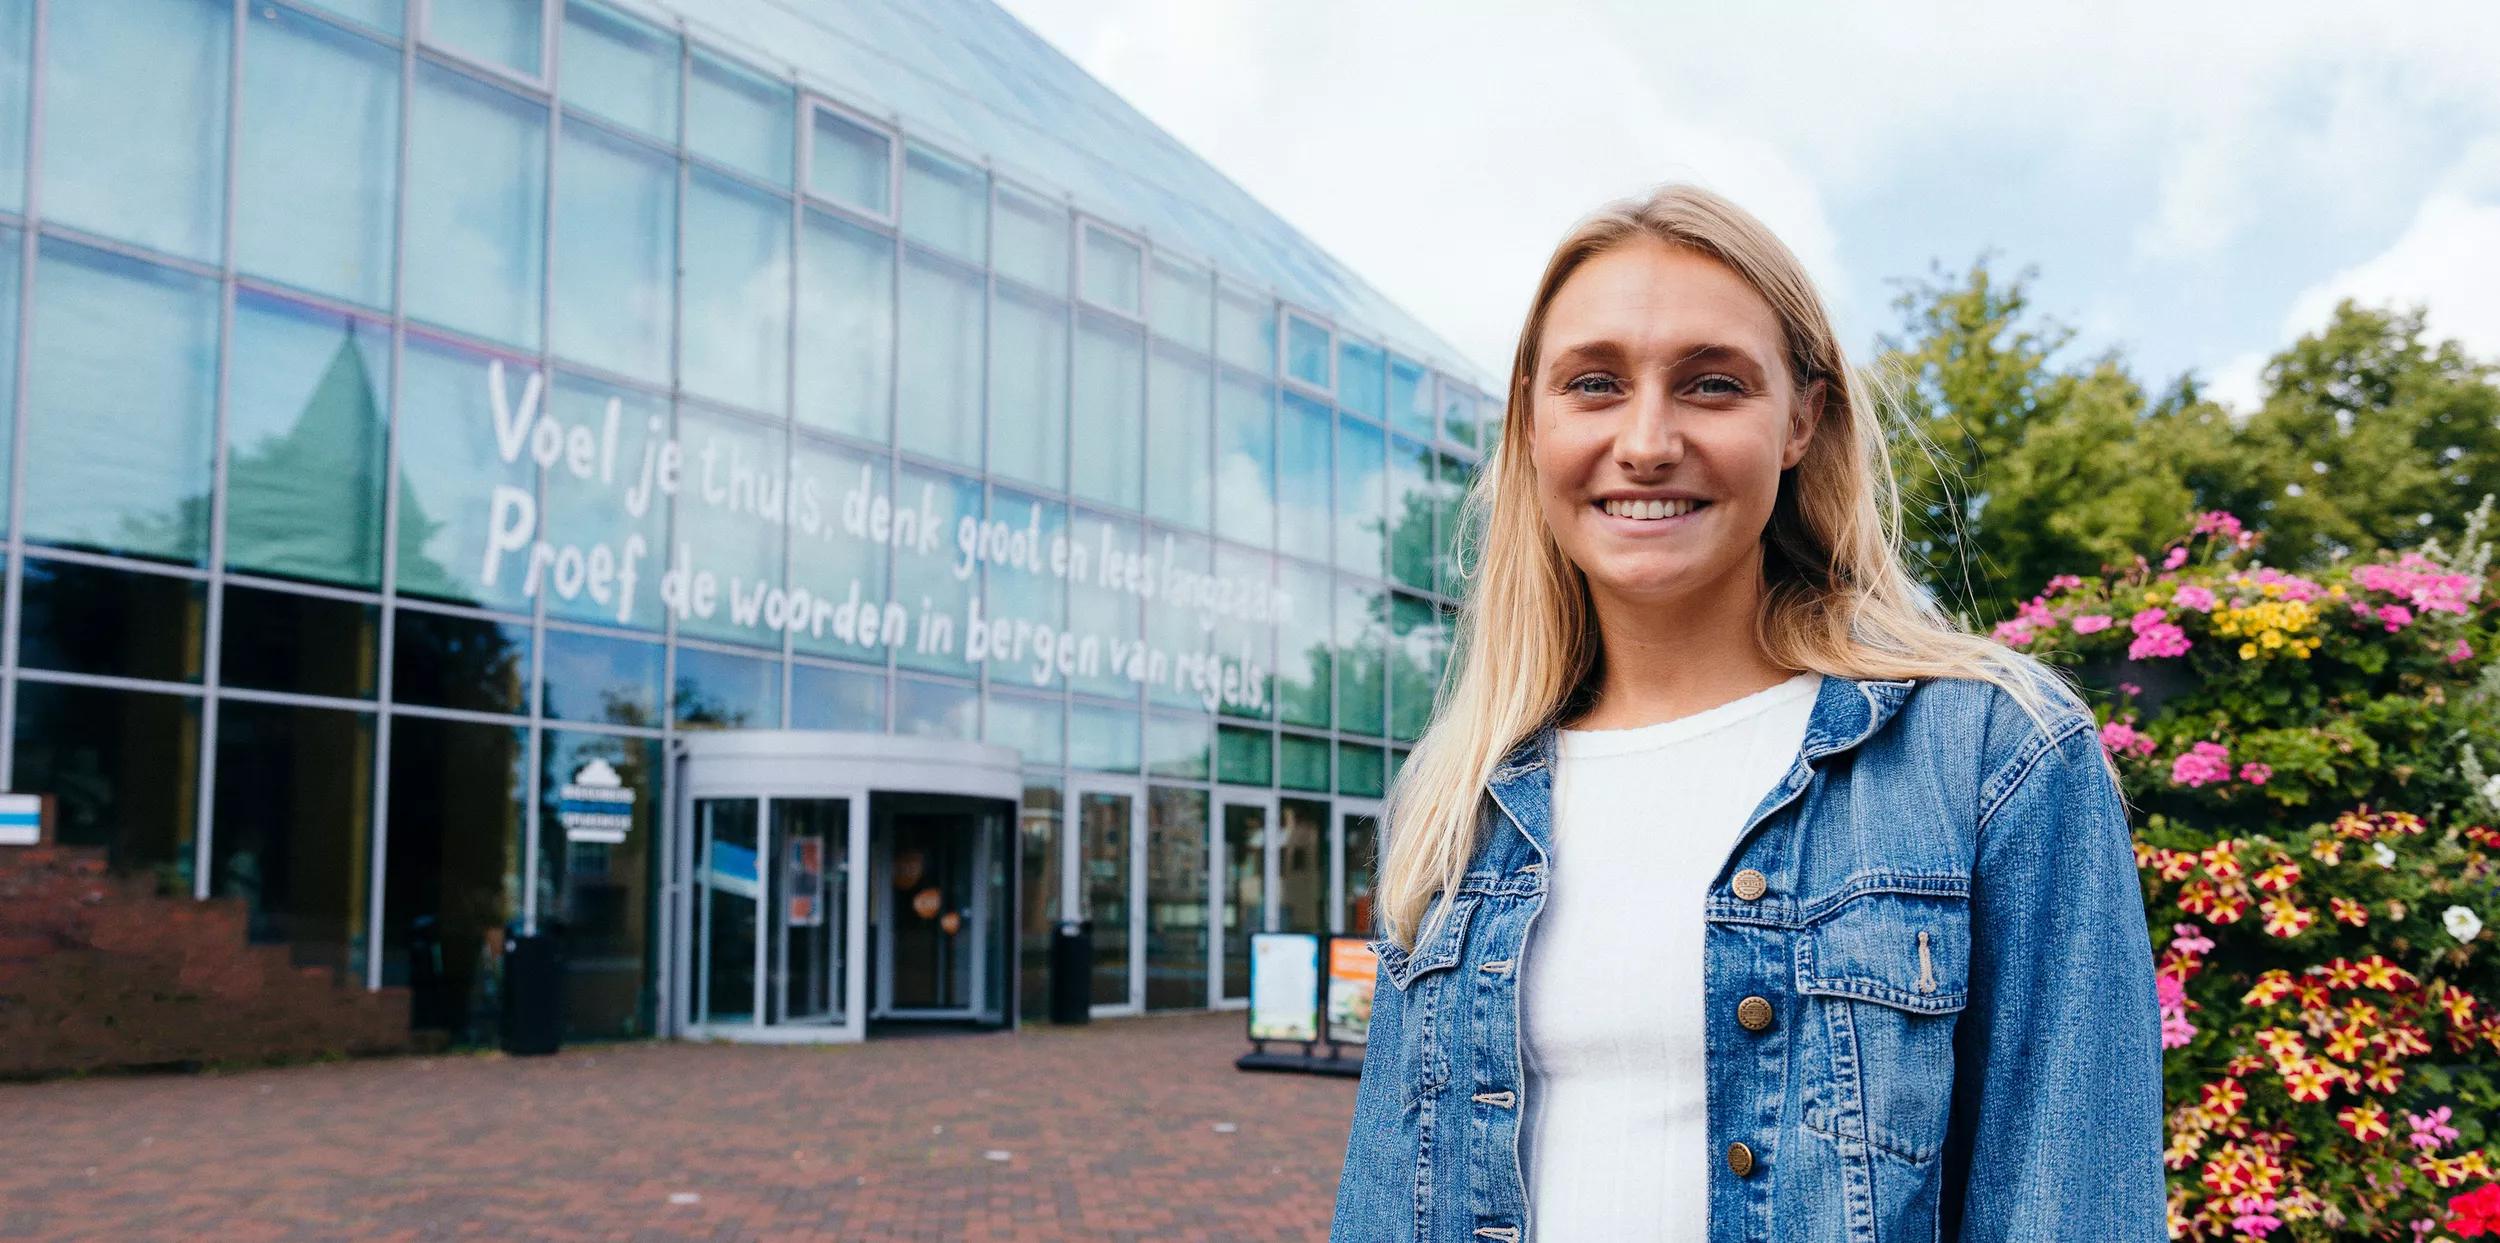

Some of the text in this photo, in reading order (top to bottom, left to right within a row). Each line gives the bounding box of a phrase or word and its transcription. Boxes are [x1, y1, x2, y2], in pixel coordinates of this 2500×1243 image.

[489, 359, 621, 482] Voel
[625, 414, 684, 518] je
[702, 437, 834, 542] thuis,
[842, 462, 942, 556] denk
[953, 501, 1042, 581] groot
[1050, 536, 1088, 581] en
[1099, 524, 1155, 598] lees
[481, 486, 1271, 714] Proef de woorden in bergen van regels.
